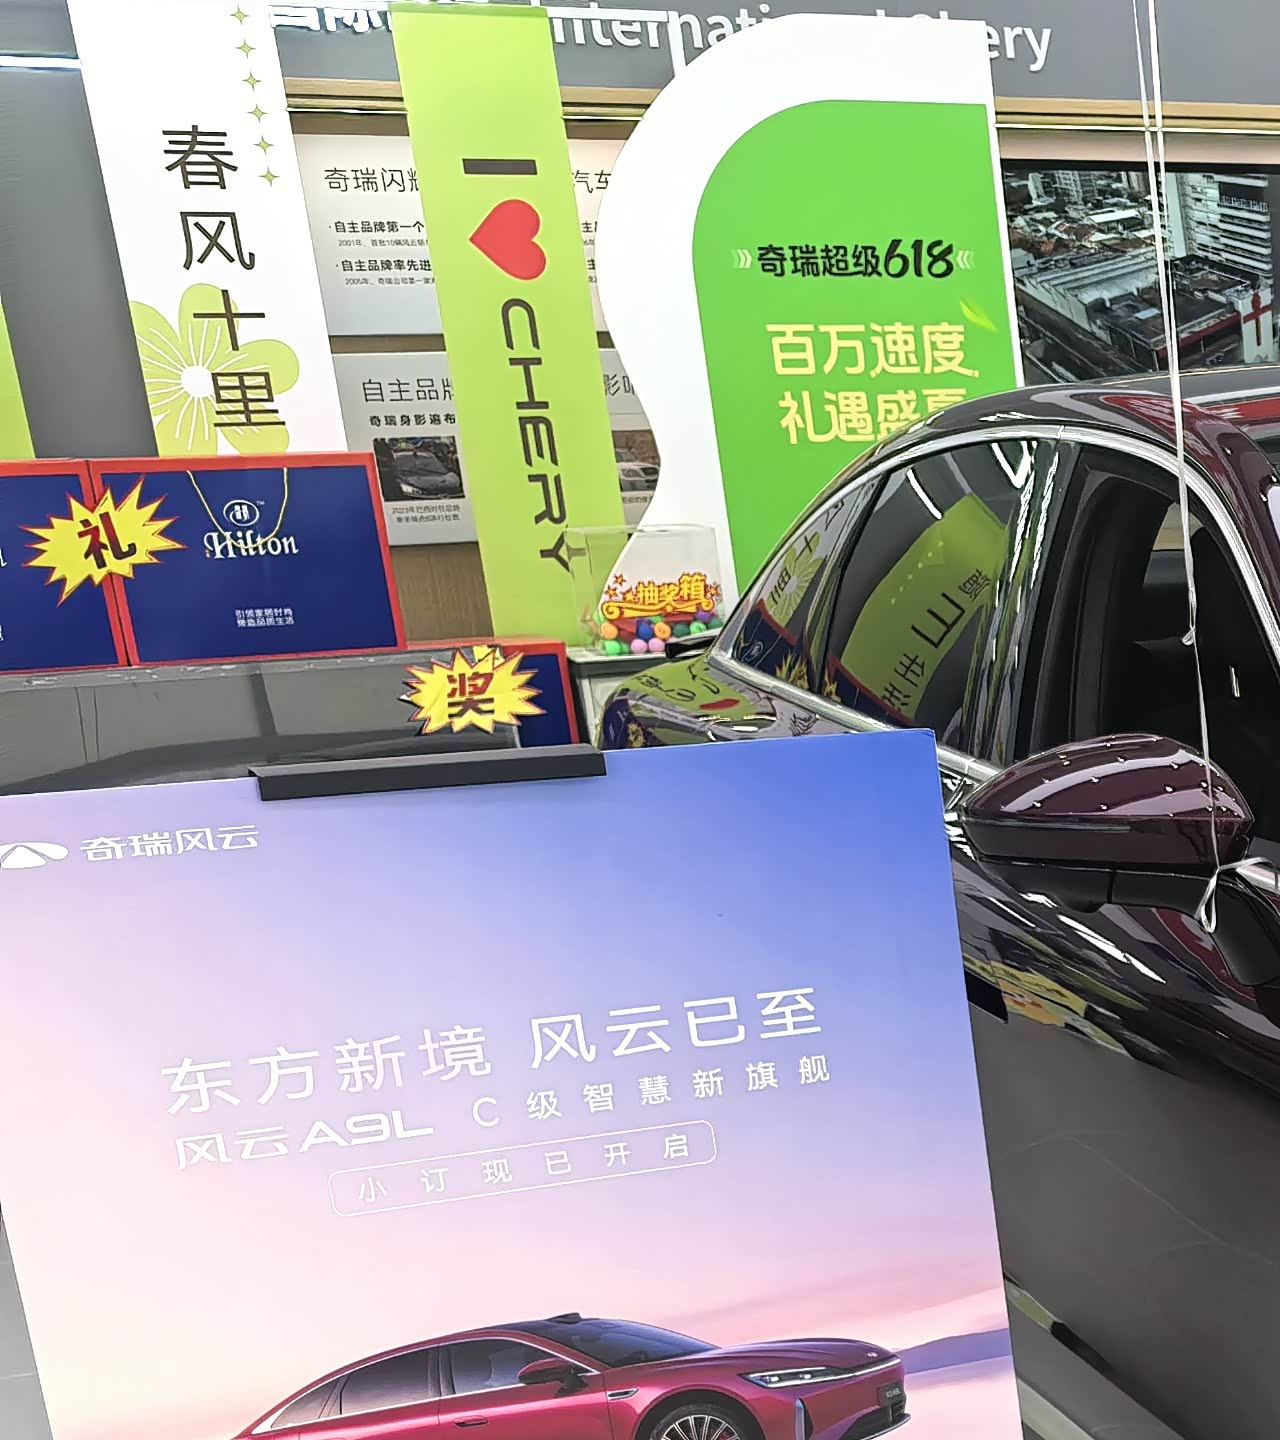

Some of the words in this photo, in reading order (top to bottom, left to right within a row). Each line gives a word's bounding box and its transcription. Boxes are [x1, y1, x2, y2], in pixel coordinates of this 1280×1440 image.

[462, 158, 537, 176] I
[334, 220, 425, 233] 自主品牌第一个
[162, 124, 286, 429] 春风十里
[757, 238, 955, 279] 奇瑞超级618
[765, 322, 979, 379] 百万速度
[501, 298, 585, 575] CHERY
[77, 512, 137, 569] 礼
[204, 530, 298, 560] Hilton
[636, 572, 707, 606] 抽奖箱
[448, 670, 495, 719] 奖
[80, 825, 259, 863] 奇瑞风云
[161, 1023, 492, 1116] 东方新境
[530, 987, 822, 1070] 风云已至
[176, 1107, 434, 1170] 风云A9L
[358, 1132, 691, 1203] 小订现已开启
